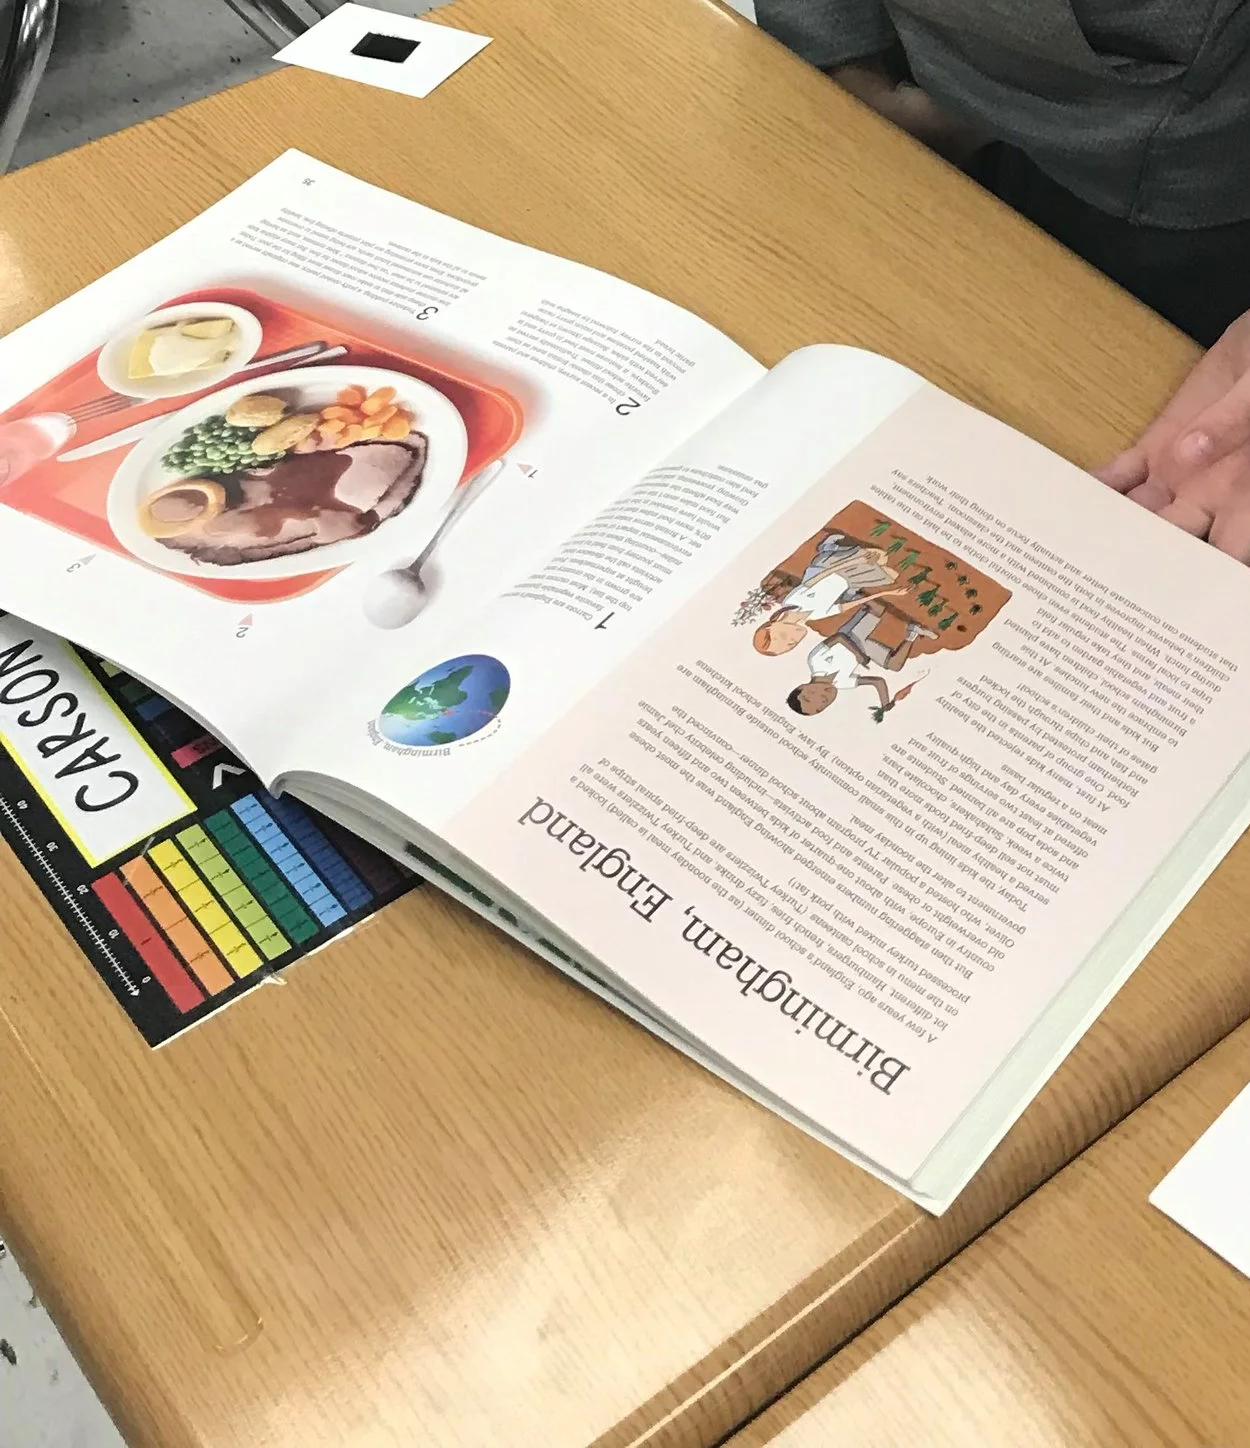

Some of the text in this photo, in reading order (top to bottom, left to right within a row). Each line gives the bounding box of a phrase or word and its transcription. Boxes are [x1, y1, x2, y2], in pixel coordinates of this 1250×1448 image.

[416, 306, 439, 321] 3
[615, 396, 642, 416] 2
[527, 468, 539, 479] 1
[65, 562, 81, 573] 3
[235, 626, 249, 639] 2
[593, 611, 615, 630] 1
[0, 639, 140, 813] CARSON
[574, 779, 609, 807] looked
[604, 800, 639, 828] called)
[636, 825, 650, 837] is
[644, 831, 673, 854] meal
[627, 729, 974, 980] But then staggering numbers emerged showing England was the most obese
[635, 716, 995, 972] country in Europe, with about one-quarter of kids between two and fifteen years
[669, 849, 713, 884] noonday
[578, 761, 949, 1031] lot different. Hamburgers, french fries, fizzy drinks, and Turkey Twizzlers were all
[596, 755, 959, 1016] on the menu in school canteens. (Turkey Twizzlers are deep-fried spiral strips of
[710, 880, 729, 898] the
[726, 893, 745, 910] (as
[742, 905, 776, 932] dinner
[514, 793, 911, 1096] Birmingham, England
[772, 928, 808, 955] school
[786, 875, 972, 1004] processed turkey mixed with pork fat!)
[805, 951, 857, 991] England's
[854, 985, 878, 1004] ago,
[875, 999, 907, 1023] years
[904, 1018, 928, 1038] few
